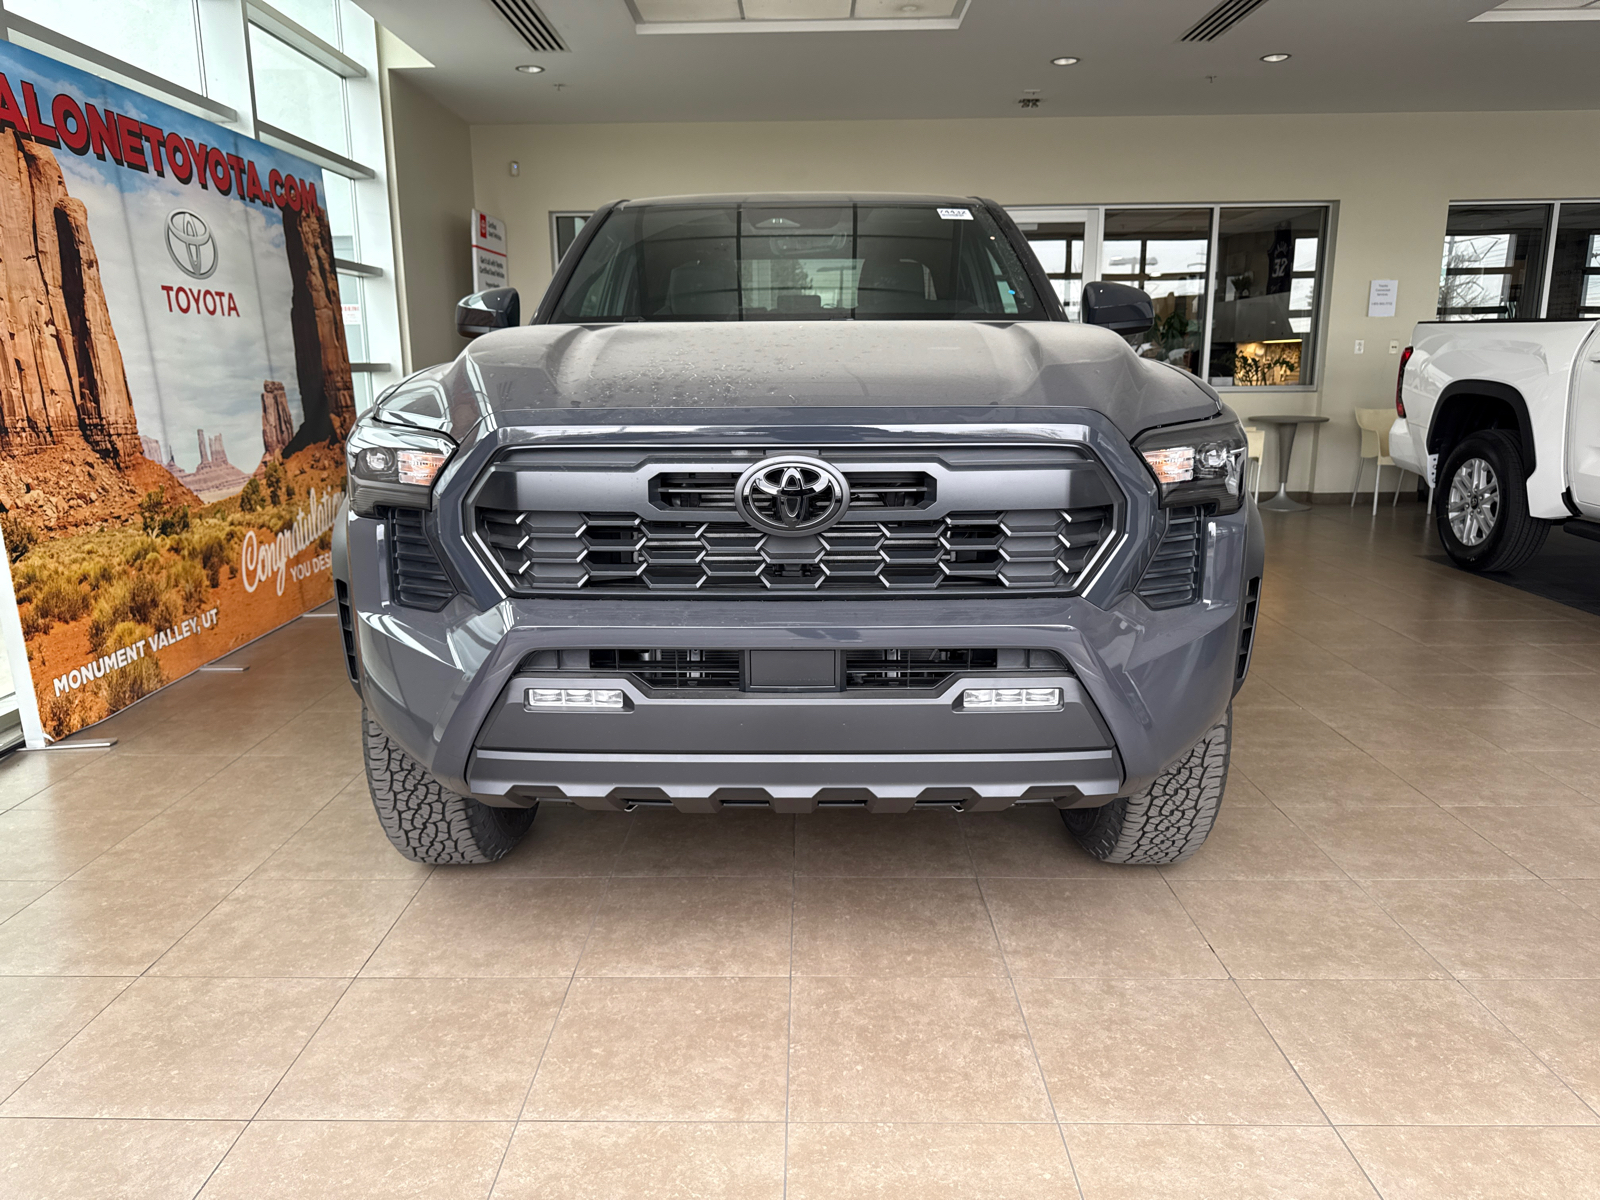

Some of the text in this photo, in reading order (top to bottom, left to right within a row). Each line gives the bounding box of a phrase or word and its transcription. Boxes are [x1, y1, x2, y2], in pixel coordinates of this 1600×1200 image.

[1272, 258, 1288, 278] 32
[161, 284, 240, 318] TOYOTA
[290, 551, 332, 582] YOU DES
[53, 608, 218, 697] MONUMENT VALLEY, UT
